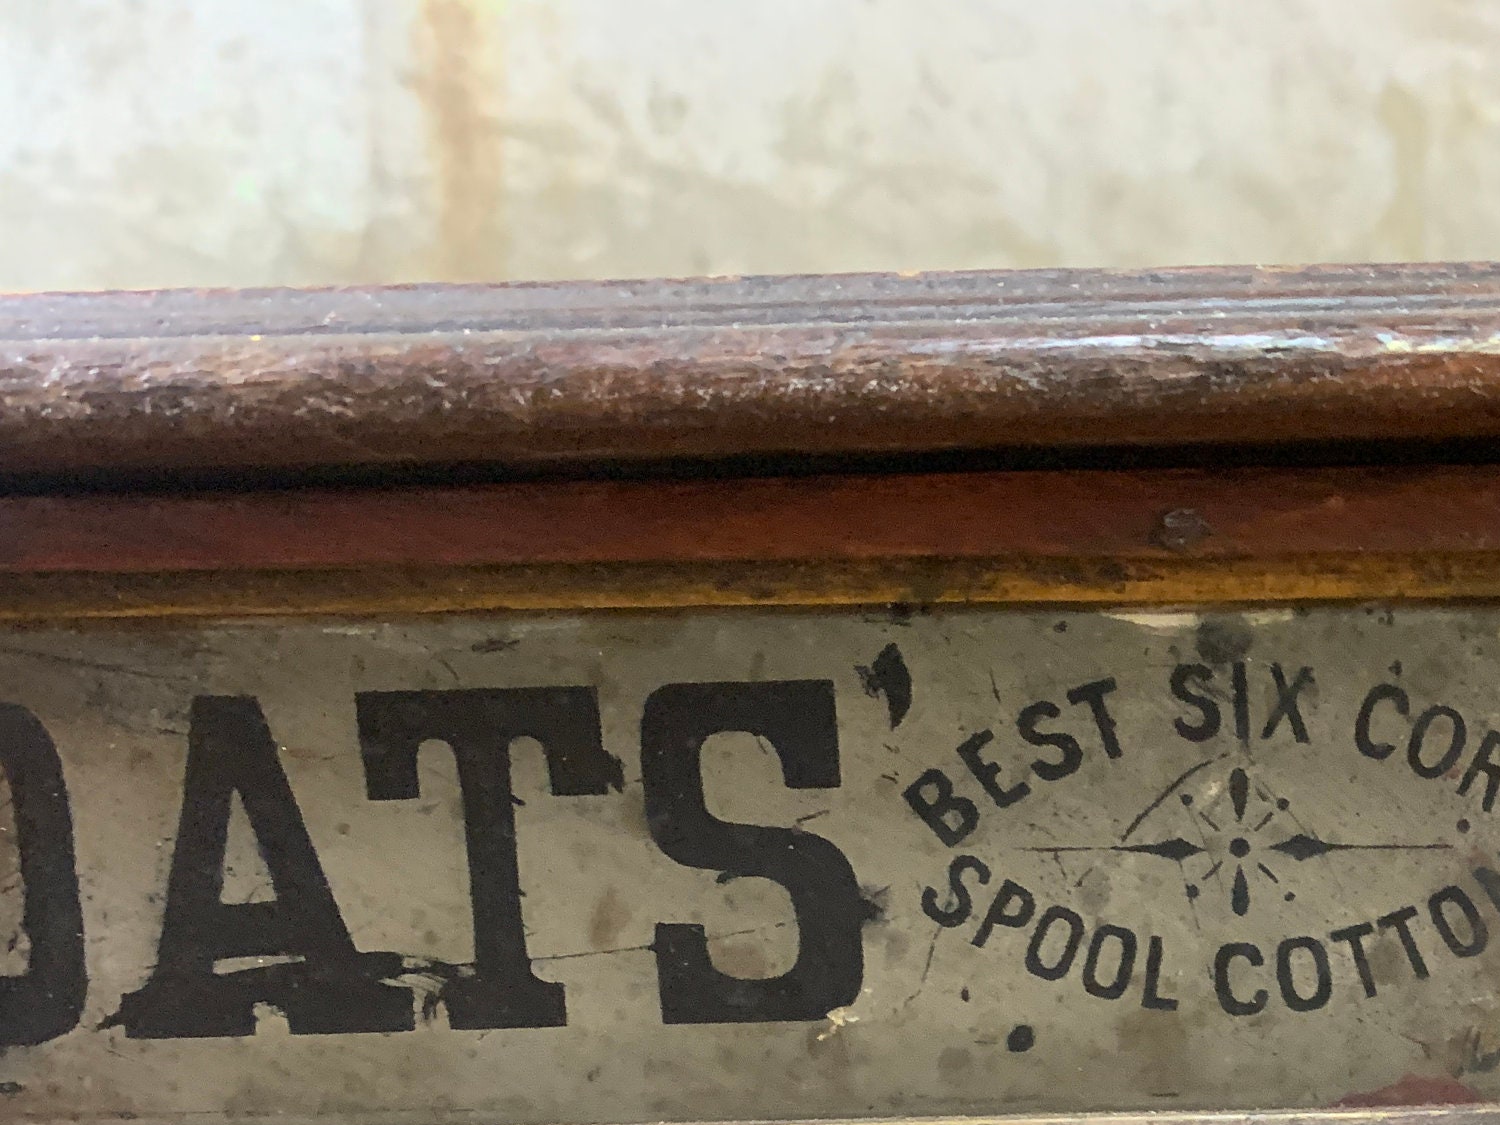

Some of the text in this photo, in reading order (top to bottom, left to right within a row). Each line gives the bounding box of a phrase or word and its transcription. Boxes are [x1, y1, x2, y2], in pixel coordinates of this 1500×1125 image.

[901, 677, 1125, 848] BEST
[1169, 661, 1315, 745] SIX
[920, 854, 1180, 1012] SPOOL
